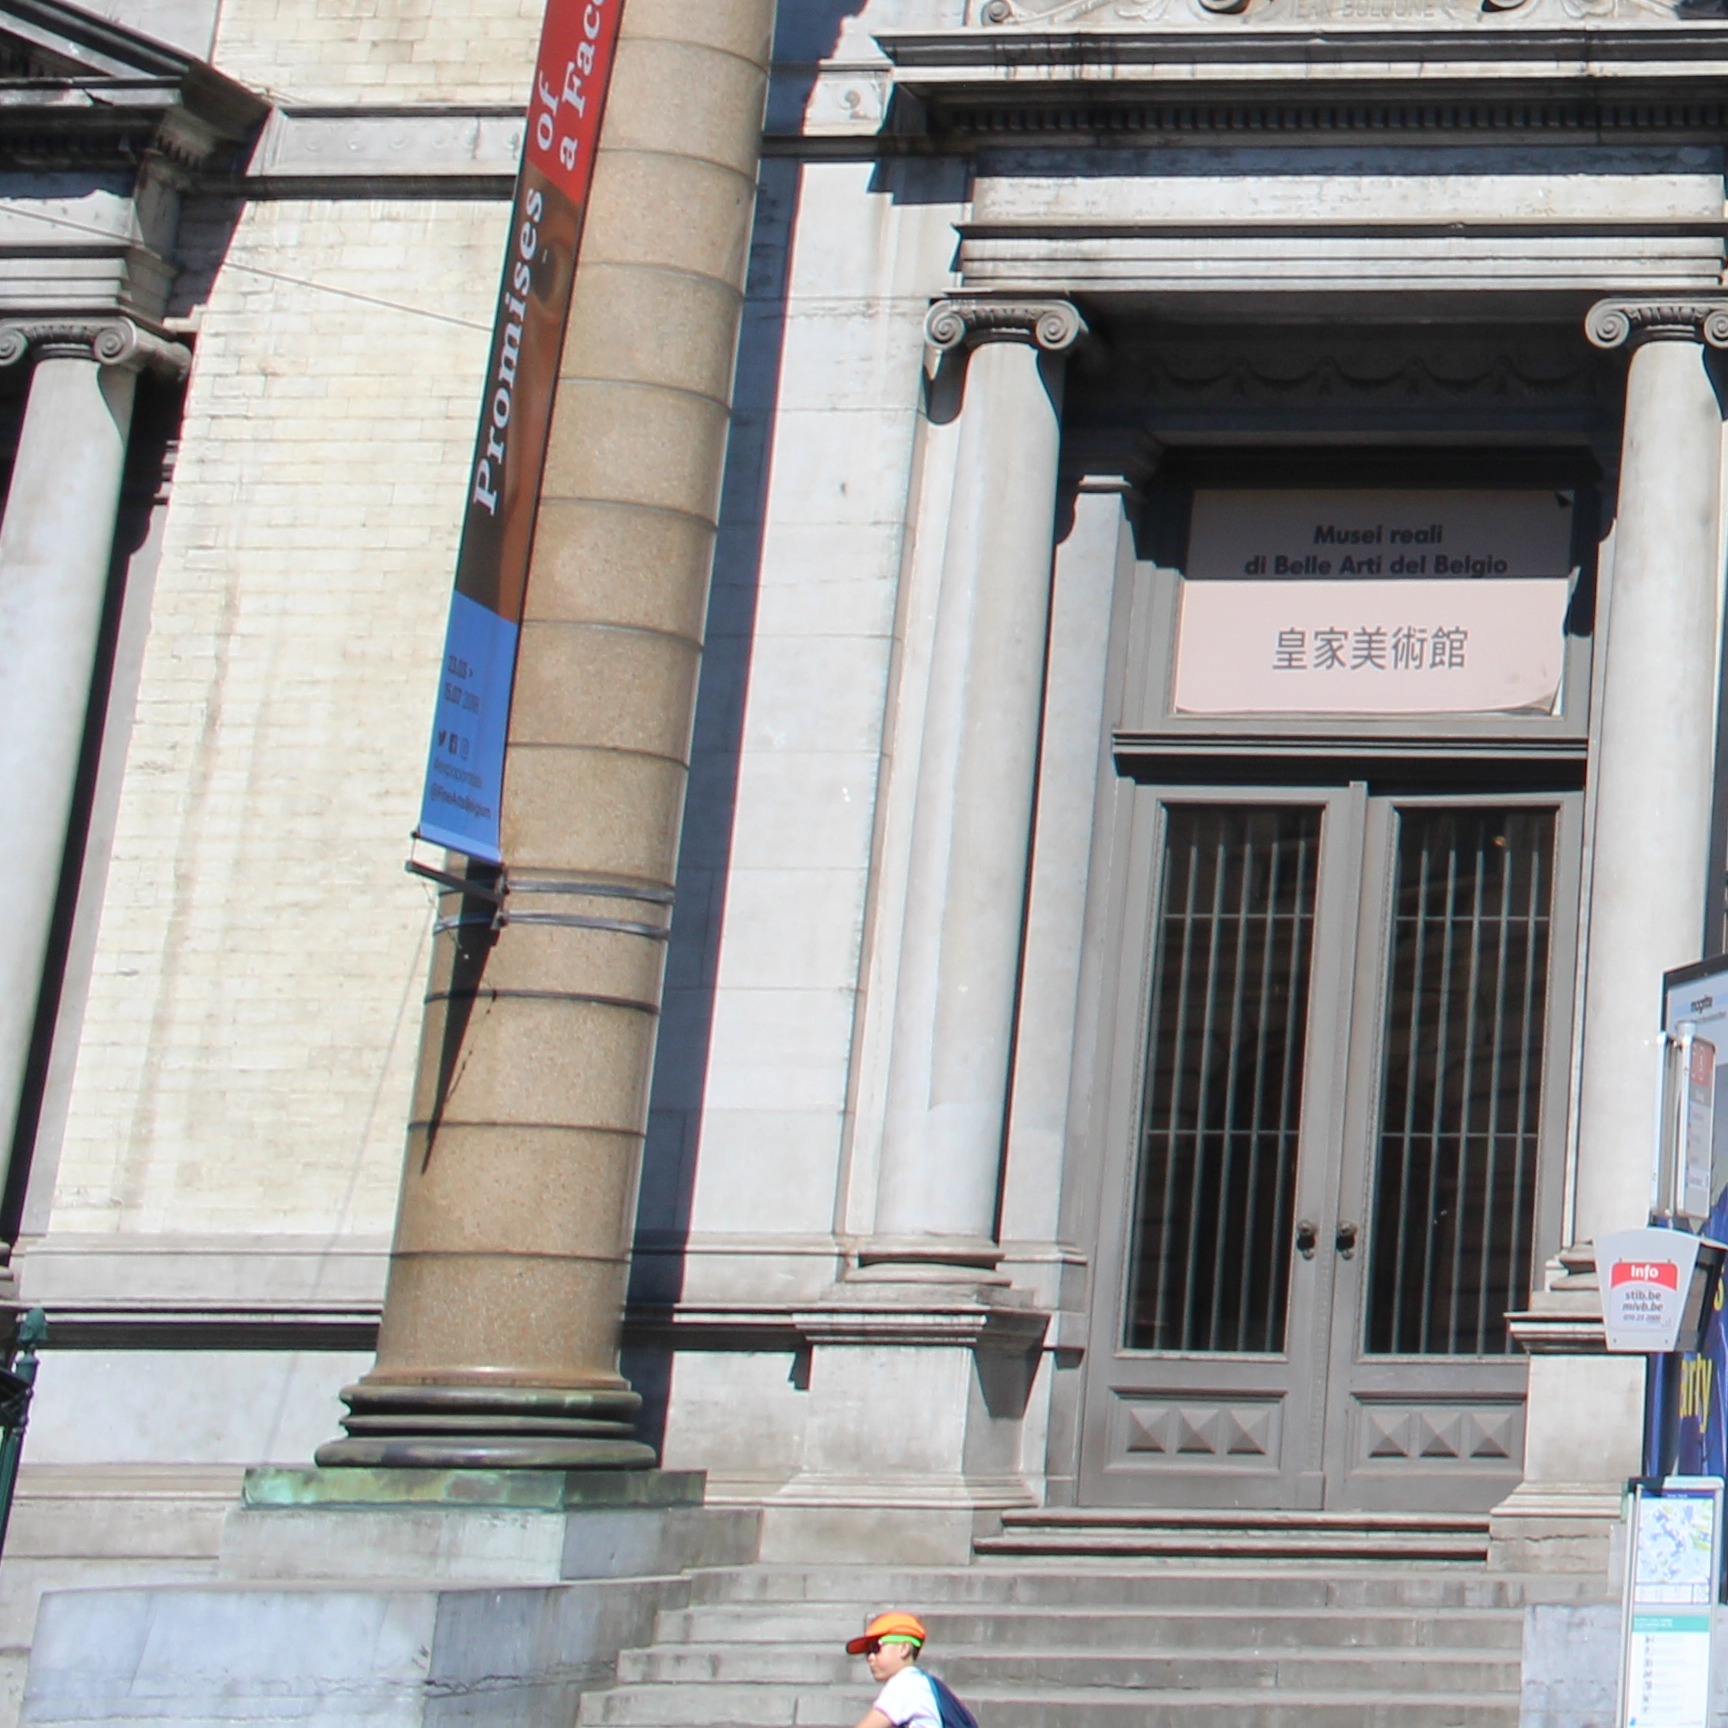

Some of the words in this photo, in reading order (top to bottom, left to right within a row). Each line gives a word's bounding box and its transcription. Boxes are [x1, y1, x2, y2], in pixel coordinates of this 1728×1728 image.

[558, 138, 577, 171] a
[473, 188, 543, 515] Promises
[535, 70, 560, 152] of
[1313, 525, 1382, 545] Musei
[1390, 524, 1443, 545] reali
[1245, 555, 1266, 576] di
[1275, 555, 1331, 575] Belle
[1338, 555, 1382, 575] Arti
[1390, 554, 1427, 575] del
[1435, 555, 1508, 579] Belgio
[1272, 626, 1468, 671] 皇家美術館
[1631, 1265, 1659, 1281] Info
[1622, 1302, 1664, 1313] mivb.be
[1625, 1290, 1662, 1301] stib.be
[1680, 1353, 1714, 1434] arty
